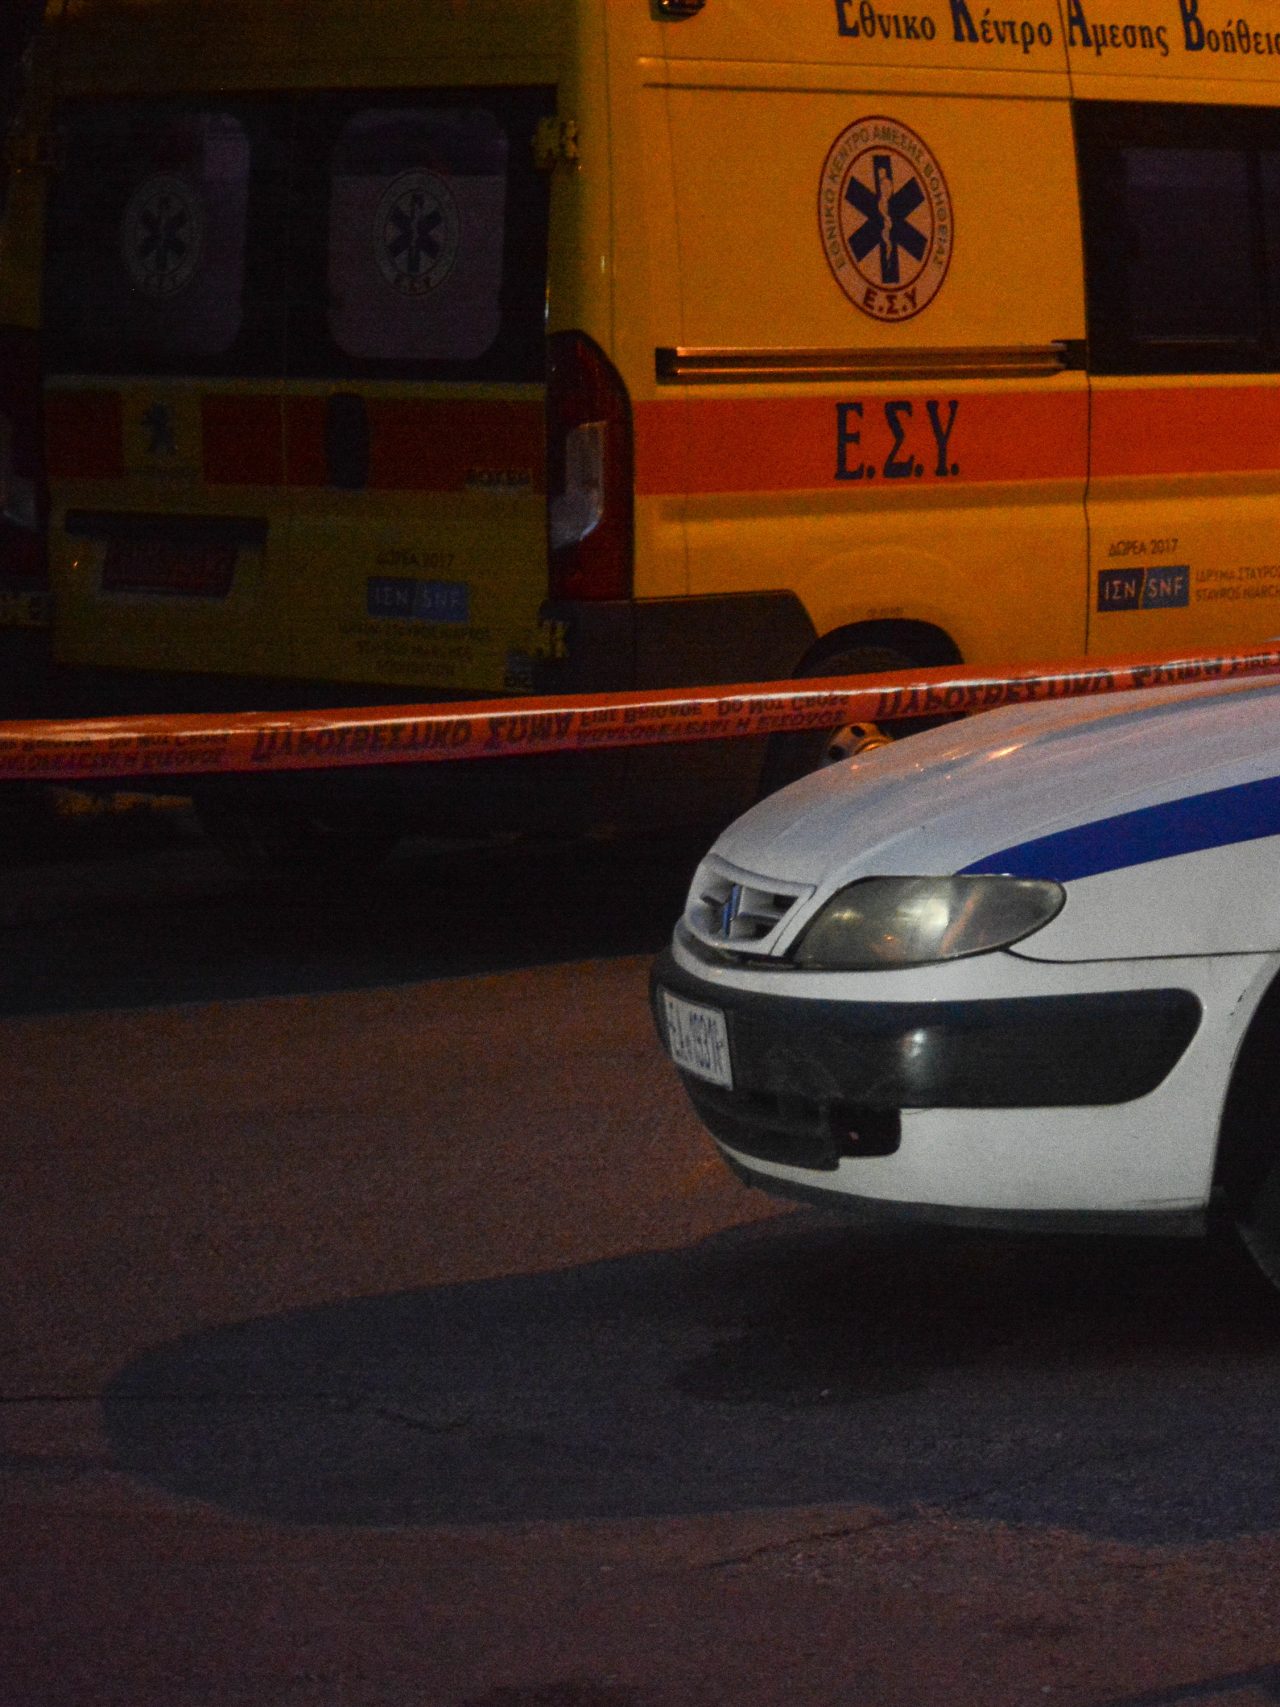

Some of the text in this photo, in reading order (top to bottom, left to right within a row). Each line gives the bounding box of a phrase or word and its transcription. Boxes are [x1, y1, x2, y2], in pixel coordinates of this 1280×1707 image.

[835, 400, 960, 480] Ε.Σ.Υ.
[1150, 538, 1179, 555] 2017
[1148, 576, 1184, 598] SNF
